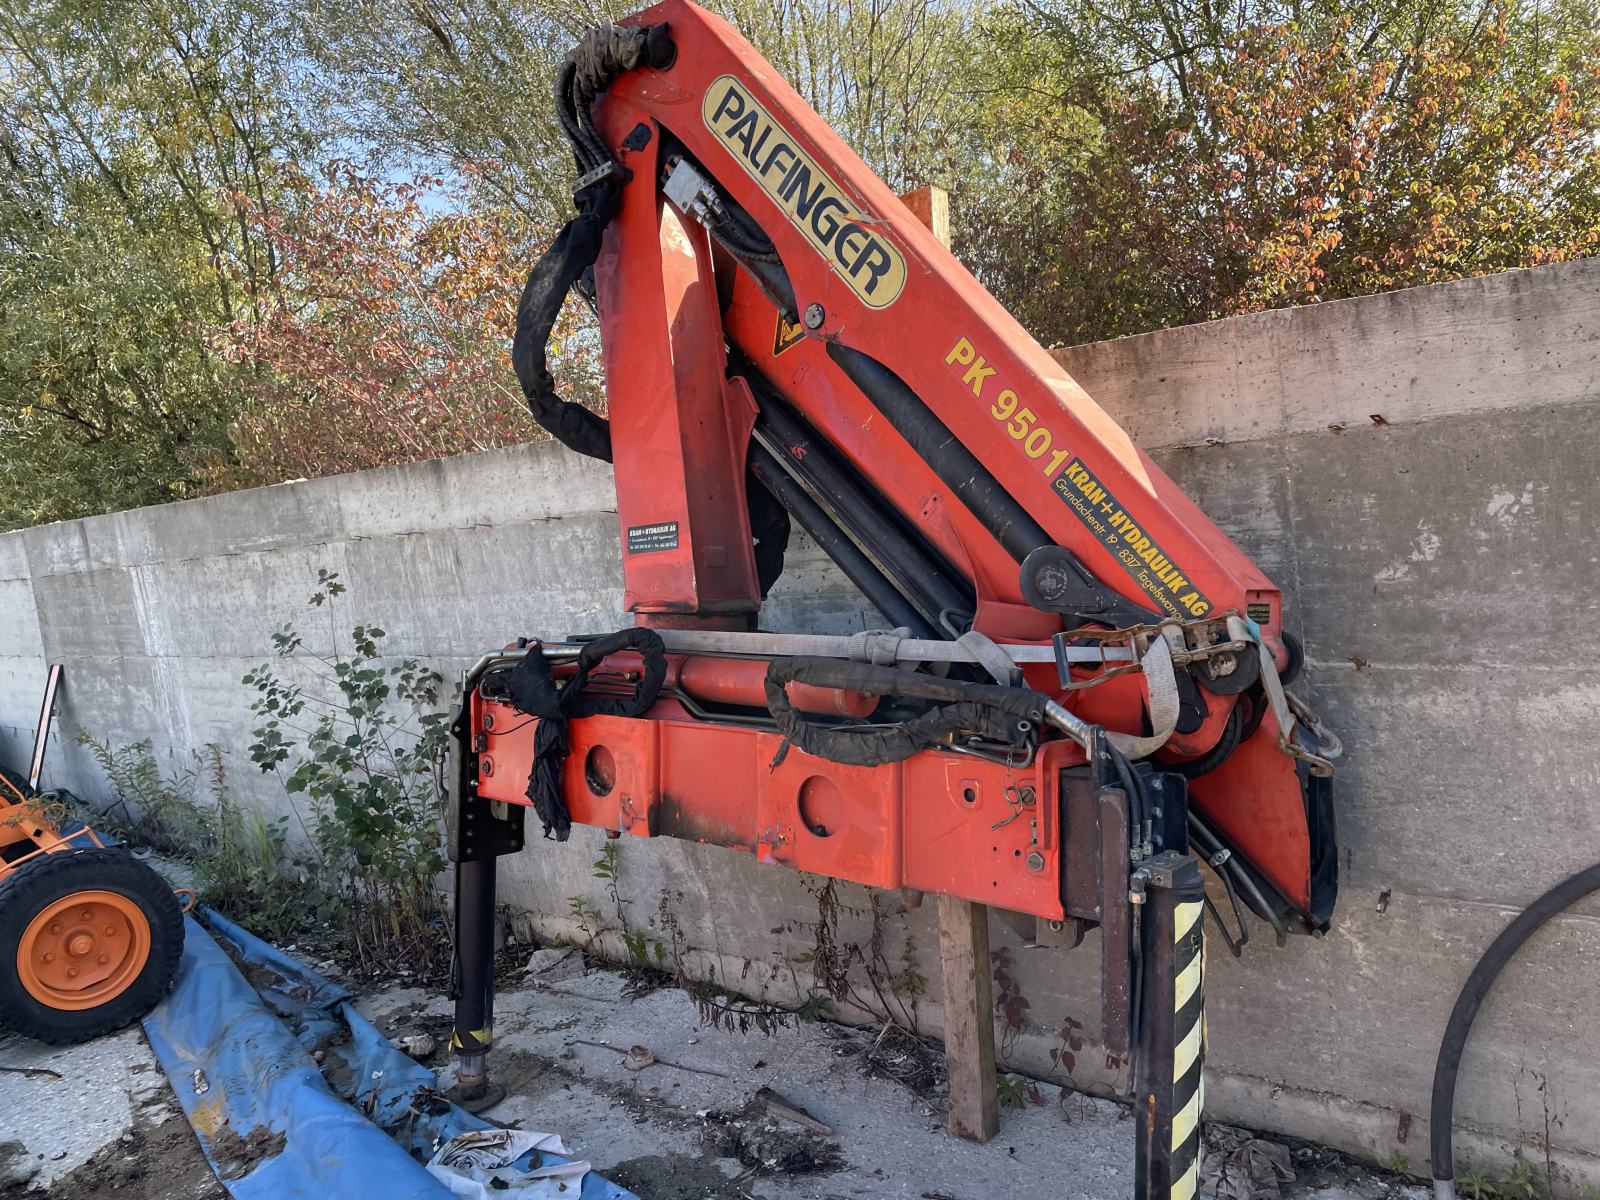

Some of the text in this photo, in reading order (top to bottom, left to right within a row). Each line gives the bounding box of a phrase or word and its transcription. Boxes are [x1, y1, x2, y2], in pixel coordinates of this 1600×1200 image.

[712, 86, 891, 296] PALFINGER
[944, 336, 1070, 477] PK 9501
[1055, 478, 1107, 536] Grundacherstr.
[1118, 549, 1141, 568] 8317
[1064, 463, 1107, 506] KRAN
[1107, 510, 1188, 594] HYDRAULIK
[1179, 591, 1209, 617] AG
